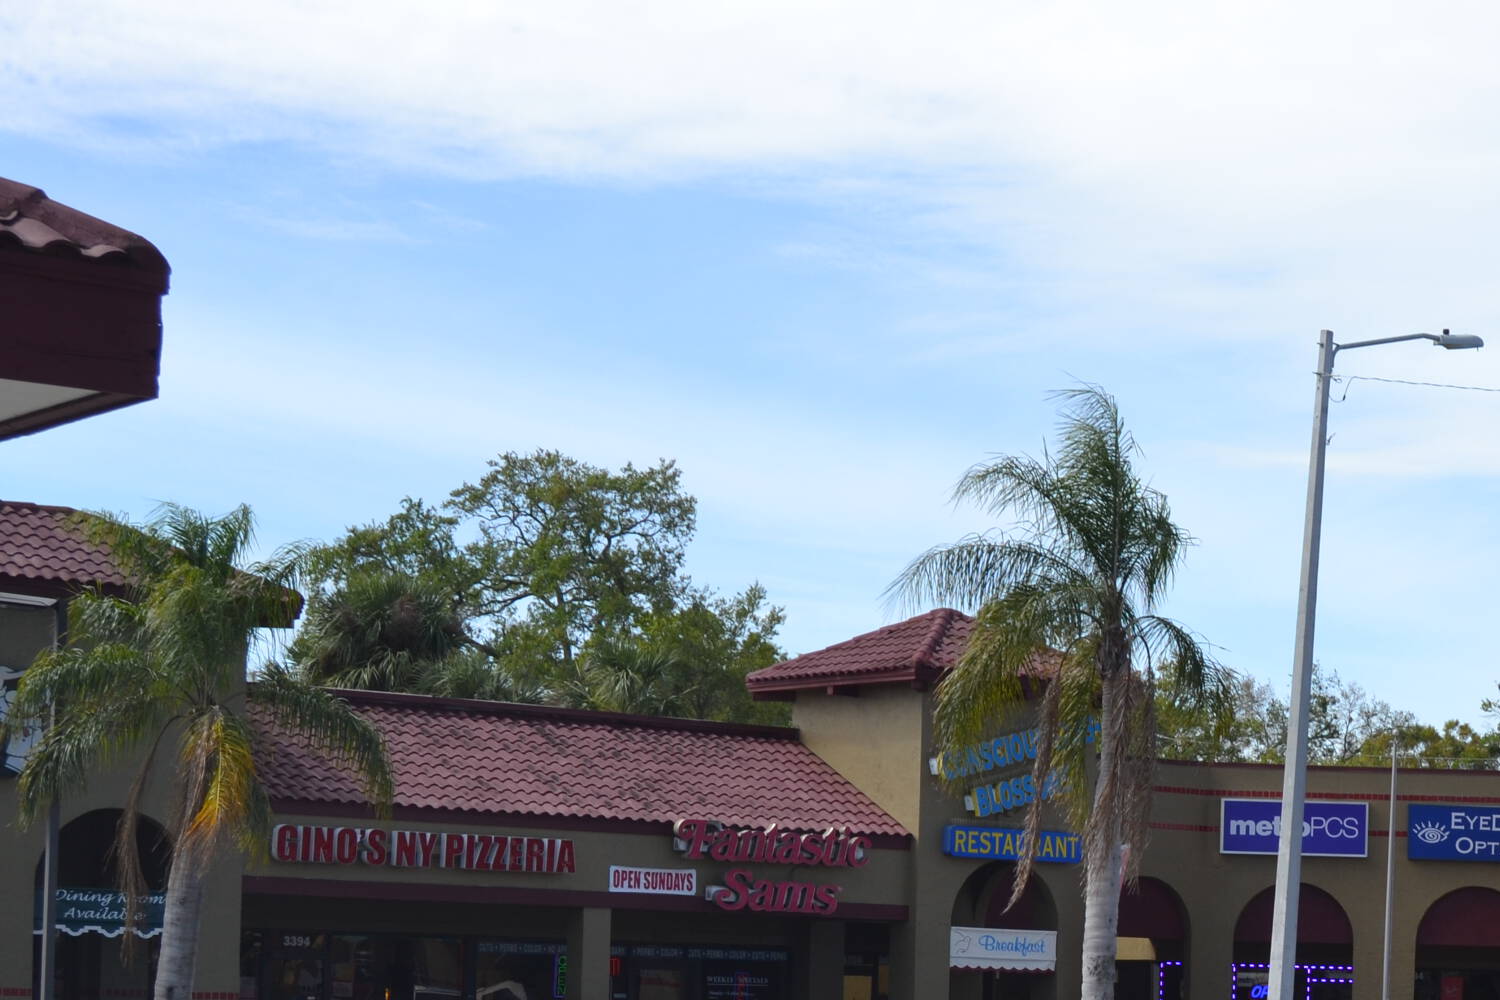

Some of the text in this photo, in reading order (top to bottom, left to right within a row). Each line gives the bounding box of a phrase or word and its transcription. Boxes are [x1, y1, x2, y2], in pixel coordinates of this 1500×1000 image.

[1230, 815, 1359, 838] metPCS
[273, 824, 576, 873] GINO'S NY PIZZERIA
[675, 818, 873, 868] Fantastic
[954, 830, 1079, 859] RESTAUANT
[613, 869, 694, 892] OPEN SUNDAYS
[714, 868, 840, 915] Sams
[55, 888, 167, 906] Dining Rom
[64, 907, 144, 921] Availabe
[283, 935, 311, 948] 3394
[978, 934, 1046, 957] Breakfast
